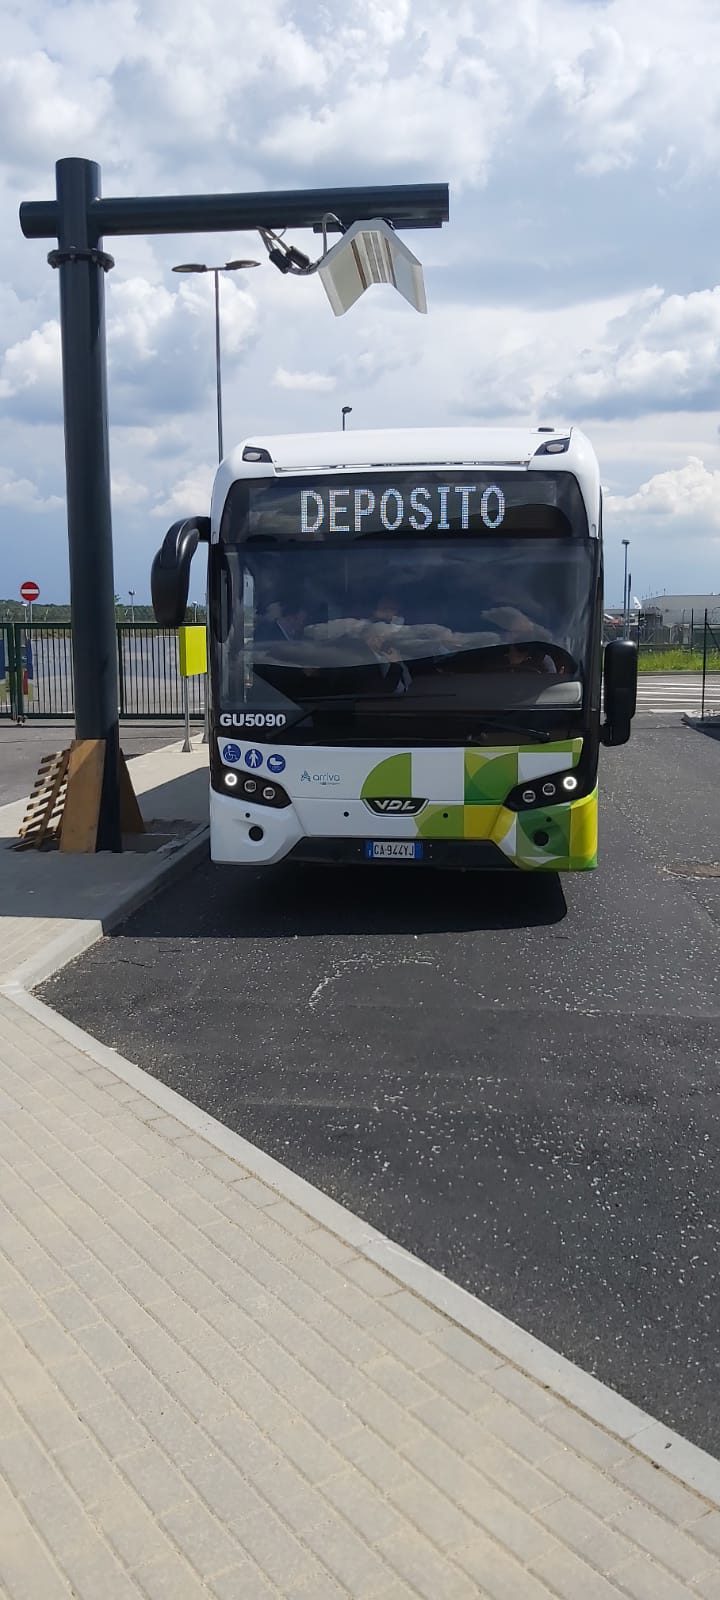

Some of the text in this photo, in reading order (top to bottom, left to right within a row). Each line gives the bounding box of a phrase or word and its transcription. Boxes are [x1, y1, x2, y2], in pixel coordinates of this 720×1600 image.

[300, 485, 506, 533] DEPOSITO
[220, 713, 286, 727] GU5090
[312, 772, 341, 782] arriva
[374, 800, 417, 811] VDL
